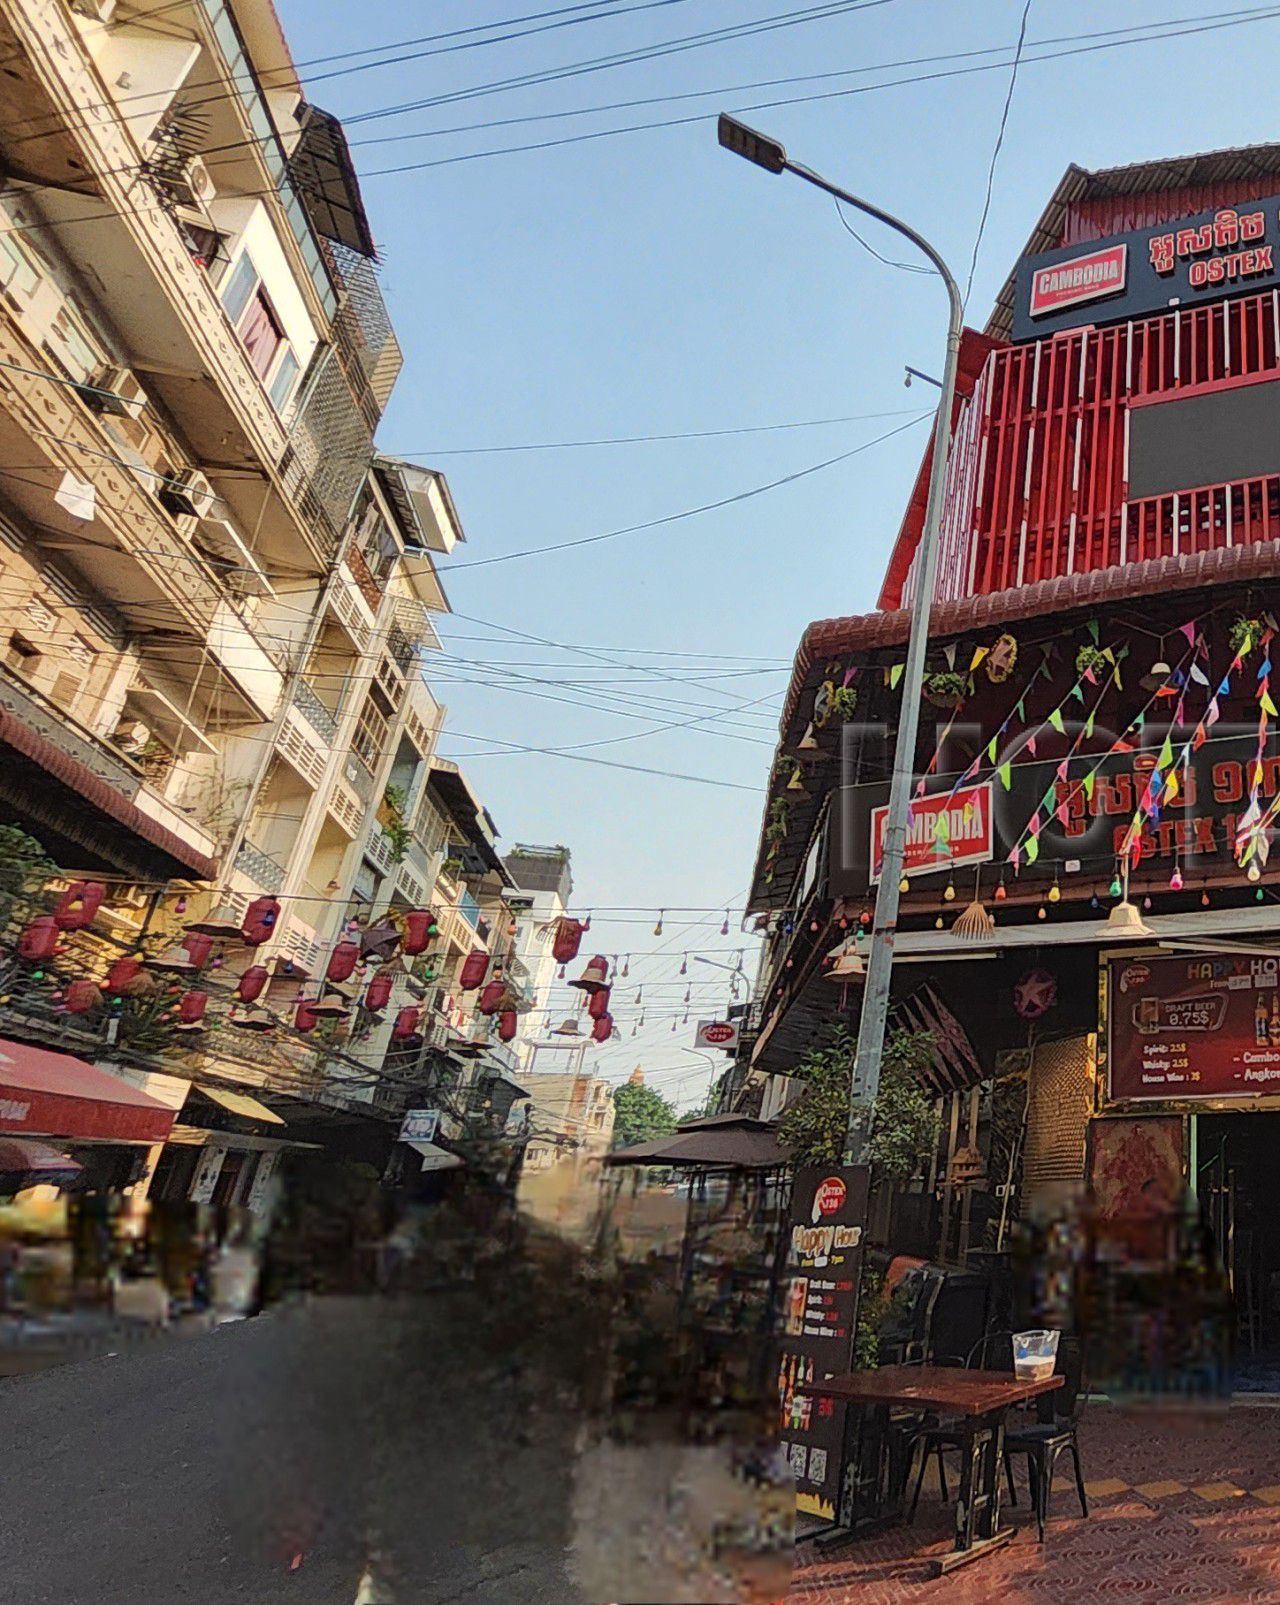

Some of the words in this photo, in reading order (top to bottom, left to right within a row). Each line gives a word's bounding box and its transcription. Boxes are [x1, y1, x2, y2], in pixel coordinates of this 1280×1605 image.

[1189, 245, 1274, 286] OSTEX
[1039, 259, 1118, 295] CAMBODIA
[1187, 960, 1247, 979] HAPPY
[1165, 1003, 1192, 1013] DRAFT
[1195, 1002, 1216, 1011] BEER
[1169, 1010, 1210, 1025] 0.75$
